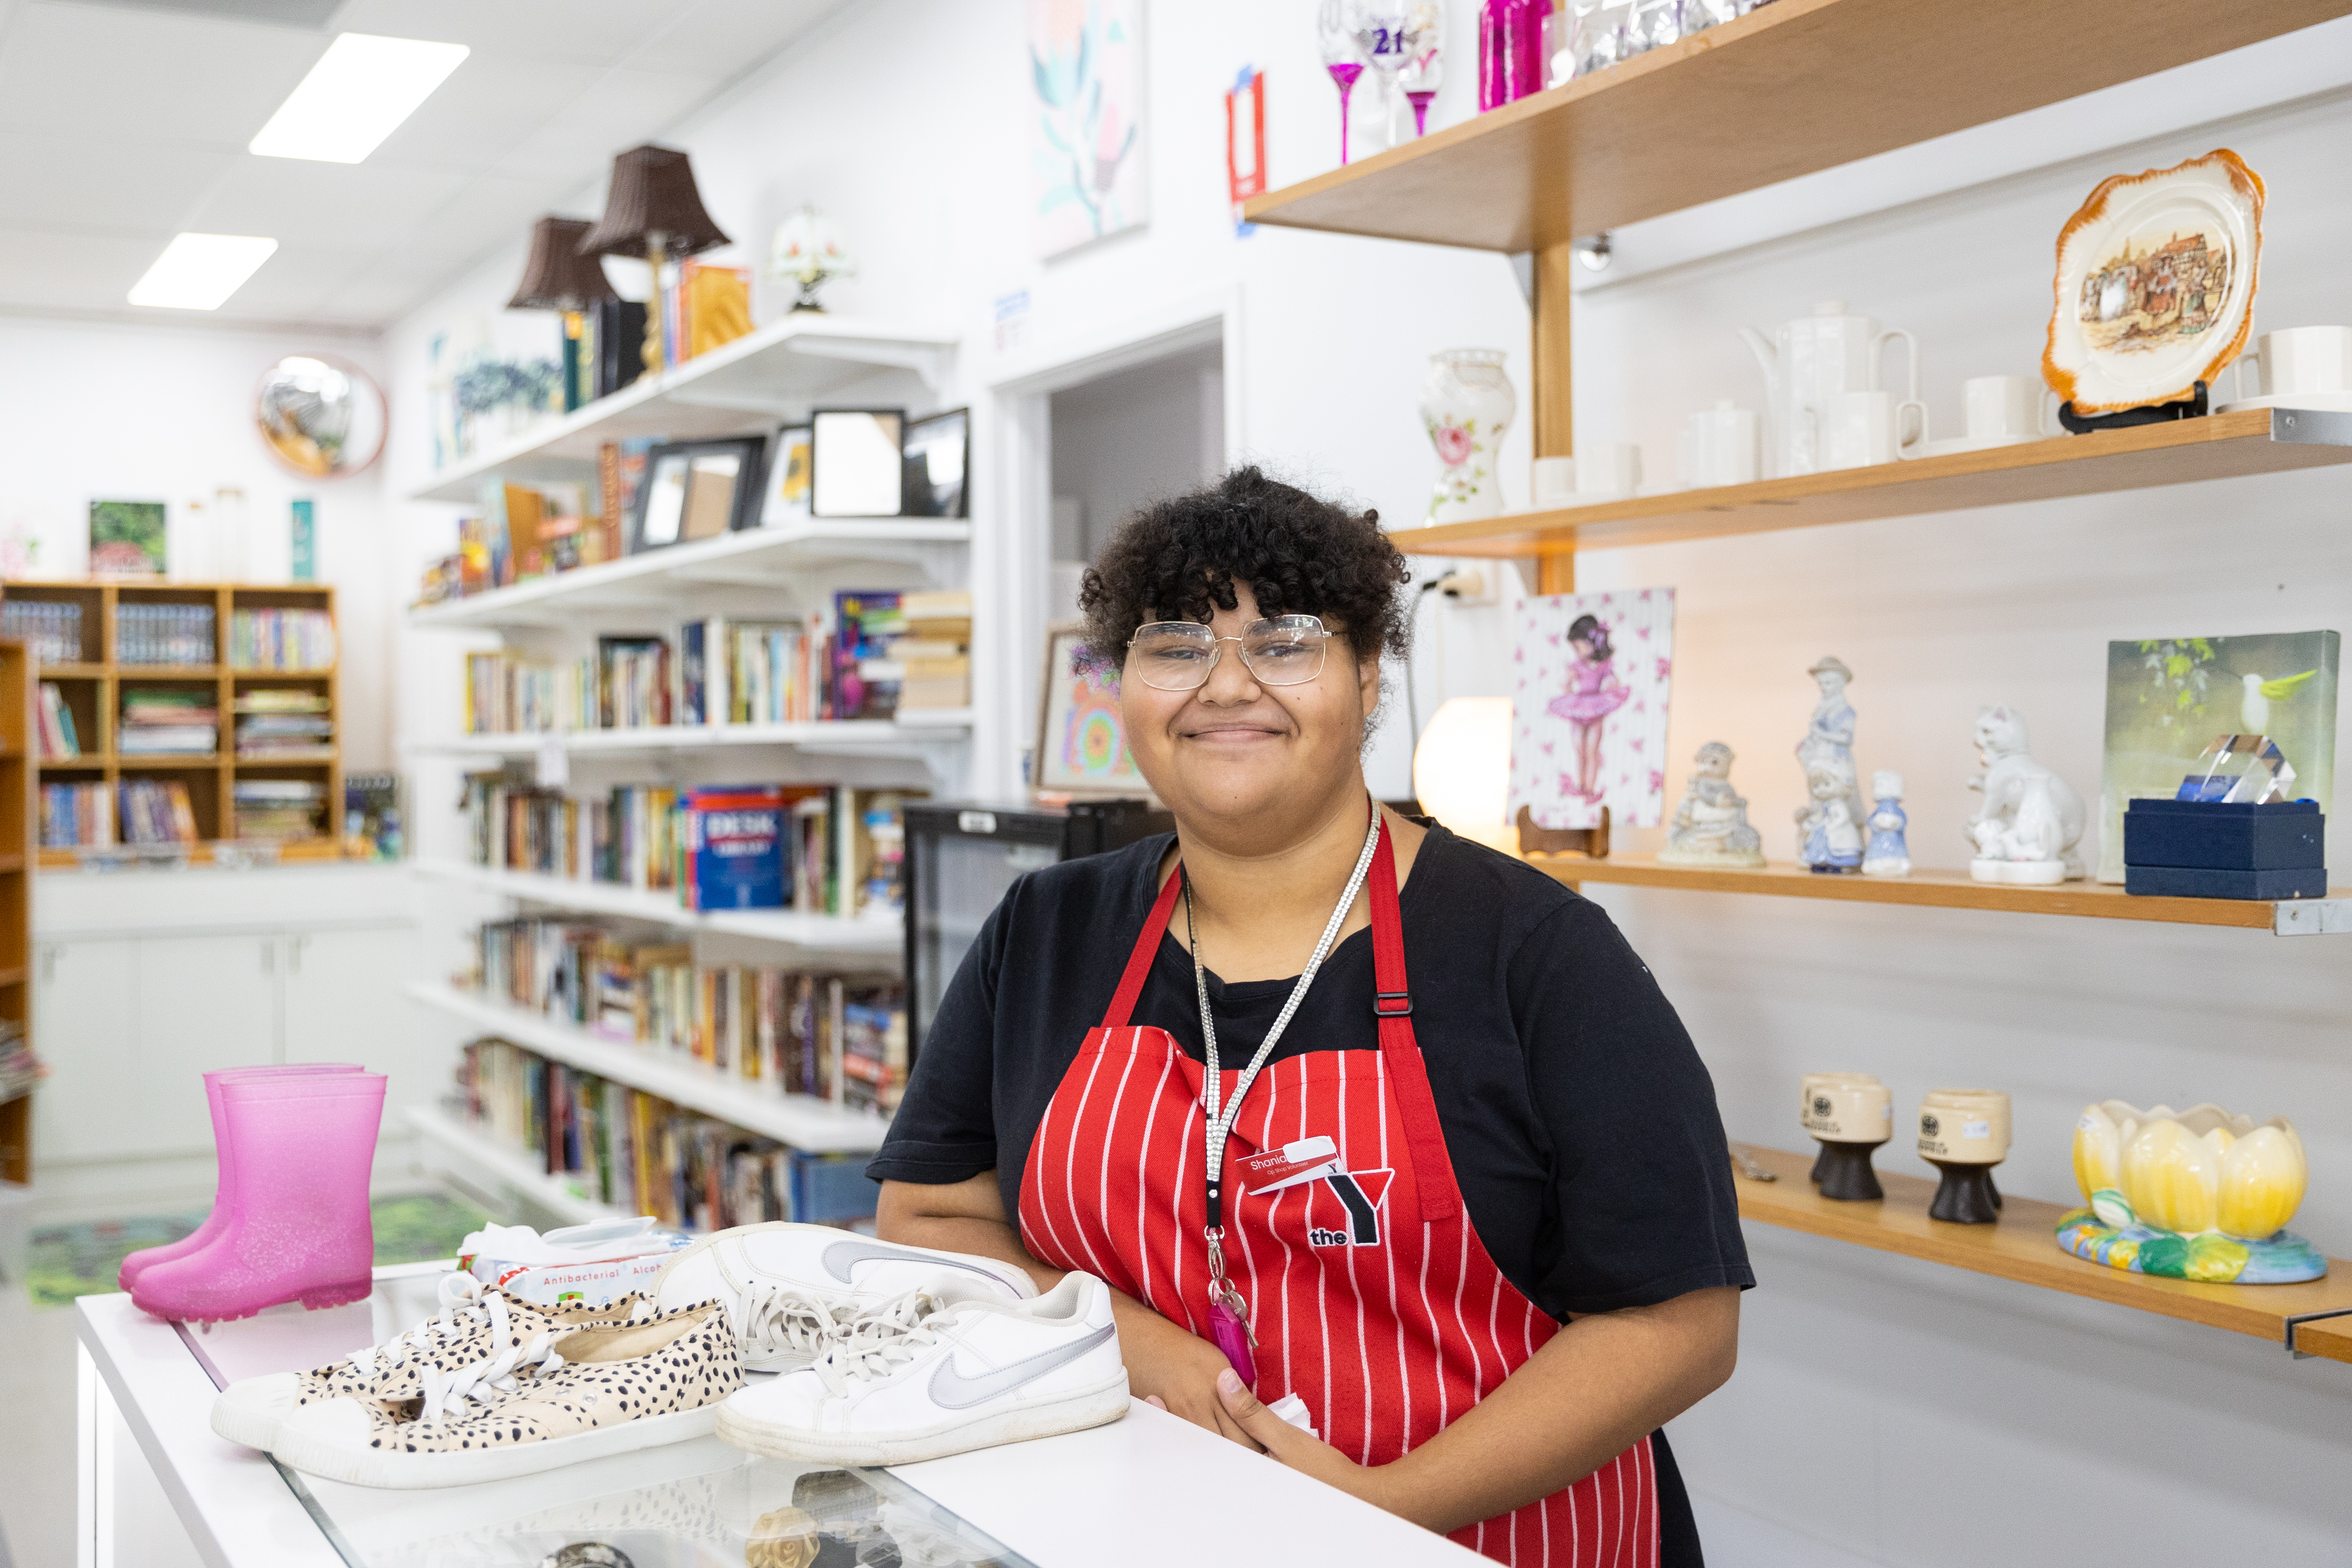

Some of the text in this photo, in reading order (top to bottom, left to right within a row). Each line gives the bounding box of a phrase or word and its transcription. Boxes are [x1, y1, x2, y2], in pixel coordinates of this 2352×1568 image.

[1372, 27, 1403, 54] 21
[1286, 1161, 1308, 1170] Volunteer
[1309, 1228, 1348, 1246] the
[543, 1269, 620, 1285] Antibacterial
